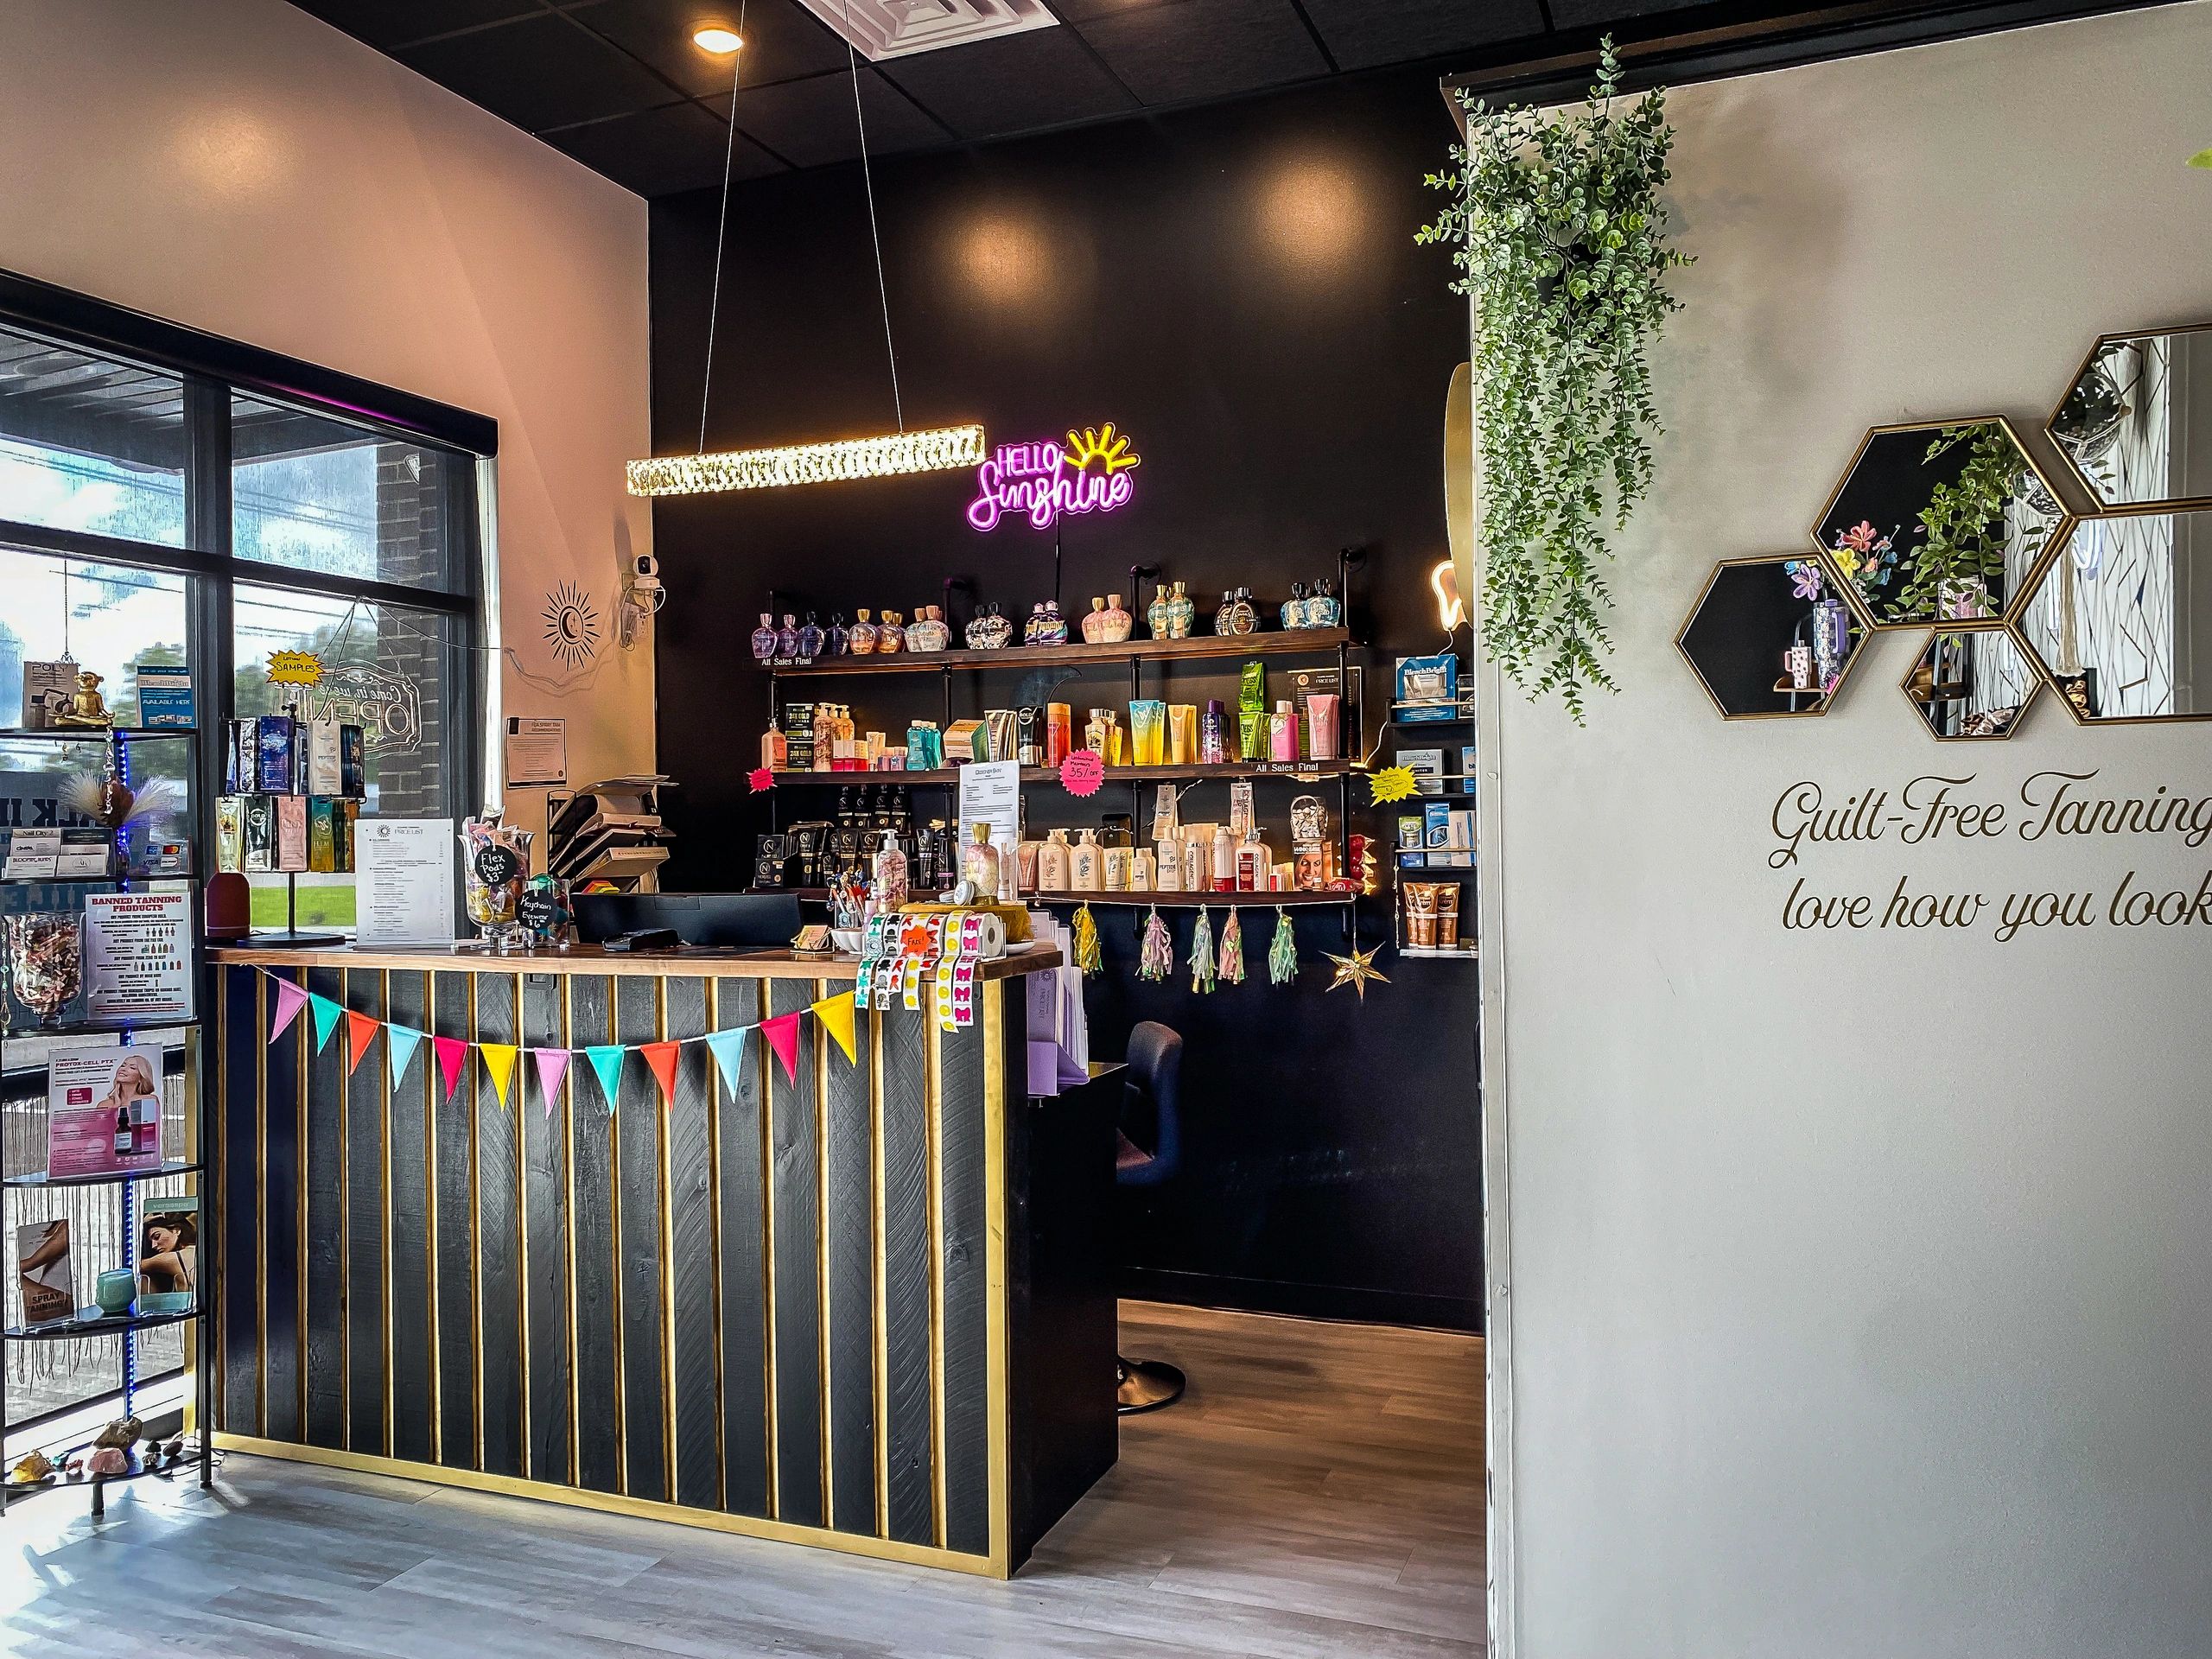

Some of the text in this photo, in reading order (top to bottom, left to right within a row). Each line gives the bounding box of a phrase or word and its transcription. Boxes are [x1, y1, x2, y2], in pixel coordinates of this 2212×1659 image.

[997, 444, 1060, 477] HELLO
[968, 450, 1130, 528] Sunshine
[276, 661, 315, 673] SAMPLES
[774, 658, 792, 666] Sales
[795, 657, 812, 665] Final
[31, 663, 67, 672] POLY
[1255, 762, 1319, 772] All Sales Final
[1766, 772, 2009, 869] Guilt-Free
[480, 853, 506, 864] Flex
[480, 864, 505, 874] Pods
[92, 896, 182, 906] BANNED TANNING
[520, 895, 552, 911] Keychain
[1782, 869, 2212, 943] love how you look
[112, 904, 164, 912] PRODUCTS
[32, 1291, 61, 1305] SPRAY
